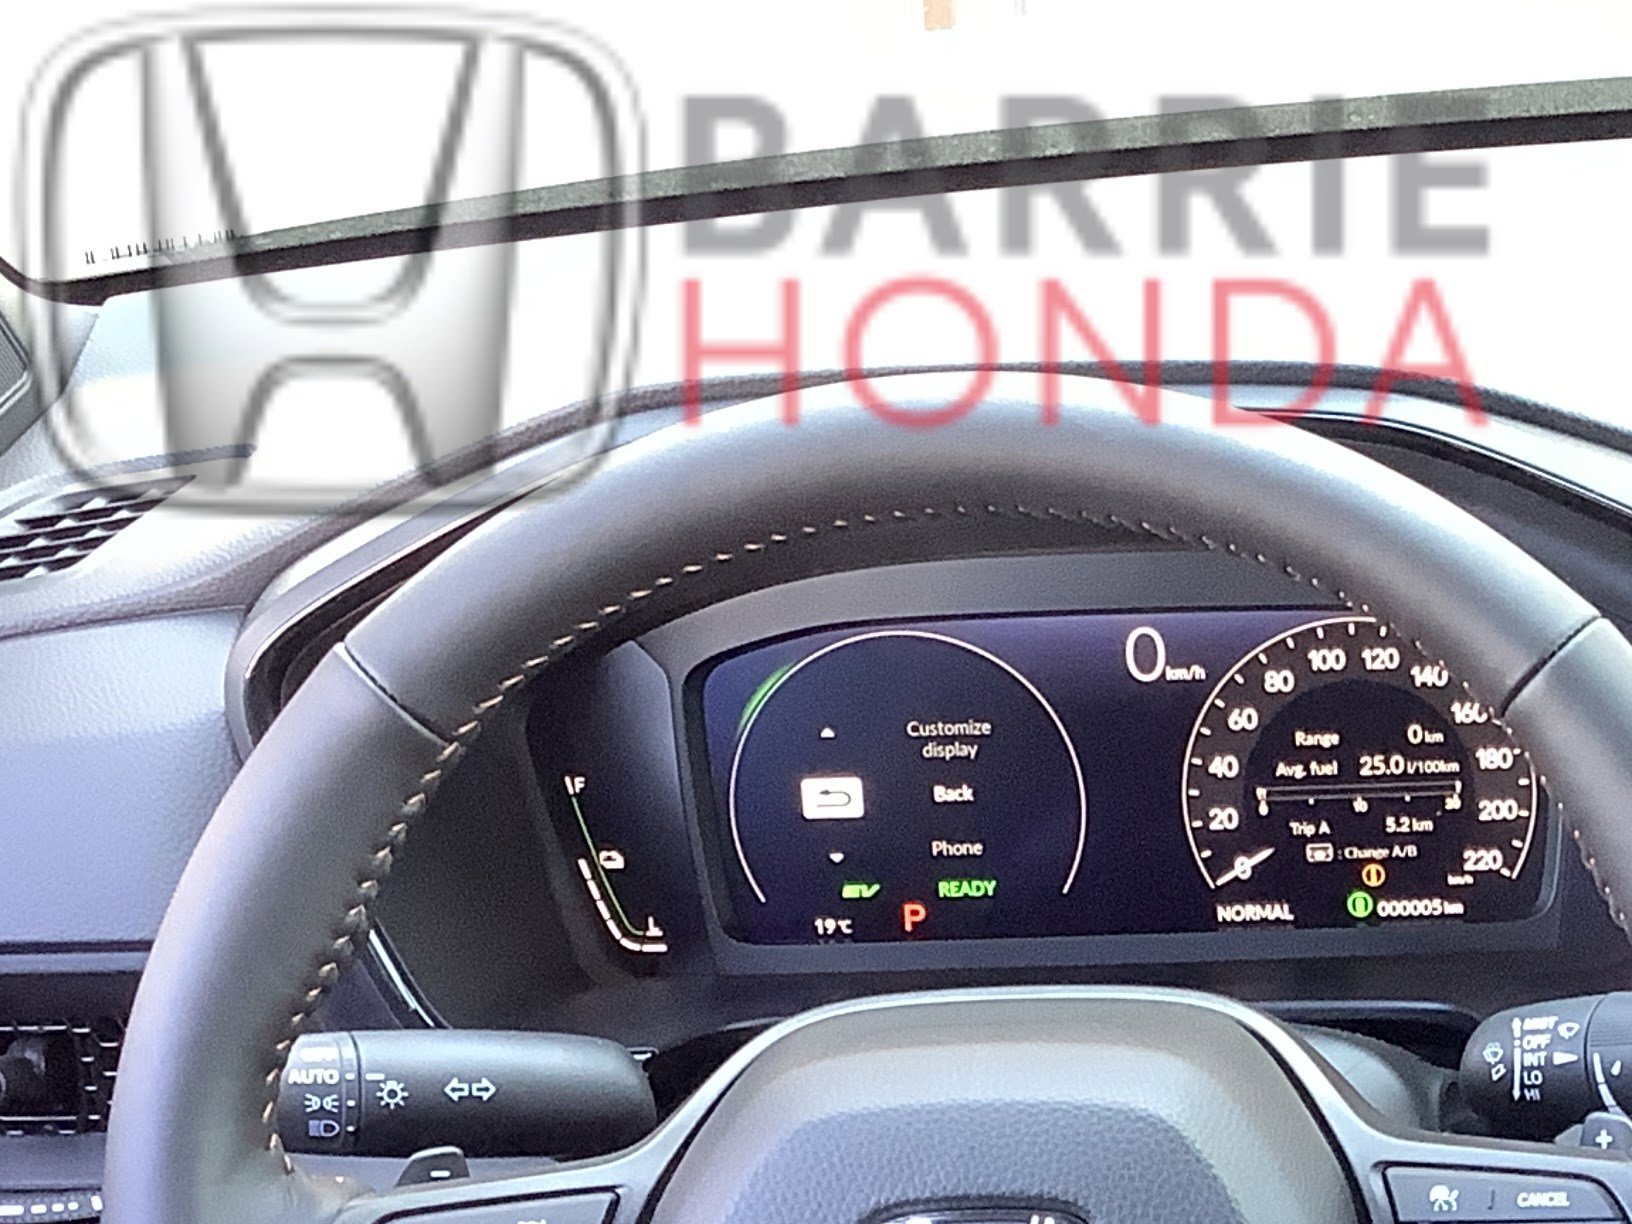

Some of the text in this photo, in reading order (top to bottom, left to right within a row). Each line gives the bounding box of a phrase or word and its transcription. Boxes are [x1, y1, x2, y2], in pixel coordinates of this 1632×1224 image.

[1125, 626, 1206, 682] 0 km/h
[1306, 648, 1347, 672] 100
[1361, 647, 1400, 671] 120
[1263, 669, 1296, 694] 80
[1410, 665, 1449, 688] 140
[906, 719, 992, 737] Customize
[1227, 707, 1259, 731] 60
[1294, 724, 1445, 748] Range 0 km
[922, 741, 978, 760] display
[1475, 748, 1514, 770] 180
[1207, 754, 1240, 778] 40
[1275, 762, 1307, 779] Avg.
[1309, 760, 1339, 776] fuel
[1359, 754, 1405, 777] 25.0
[933, 784, 974, 802] Back
[1208, 807, 1239, 830] 20
[1478, 799, 1518, 821] 200
[1288, 816, 1434, 837] Trip A 5.2 km
[931, 840, 983, 857] Phone
[1343, 845, 1418, 860] Change A/B
[1462, 850, 1504, 872] 220
[937, 880, 996, 898] READY
[903, 903, 927, 932] P
[1216, 903, 1295, 922] NORMAL
[1376, 898, 1442, 918] 000005
[1522, 1033, 1552, 1050] OFF
[1522, 1051, 1548, 1067] INT
[287, 1068, 340, 1085] AUTO
[1523, 1070, 1544, 1086] LO
[1523, 1088, 1541, 1101] HI
[1517, 1191, 1571, 1207] CANCEL
